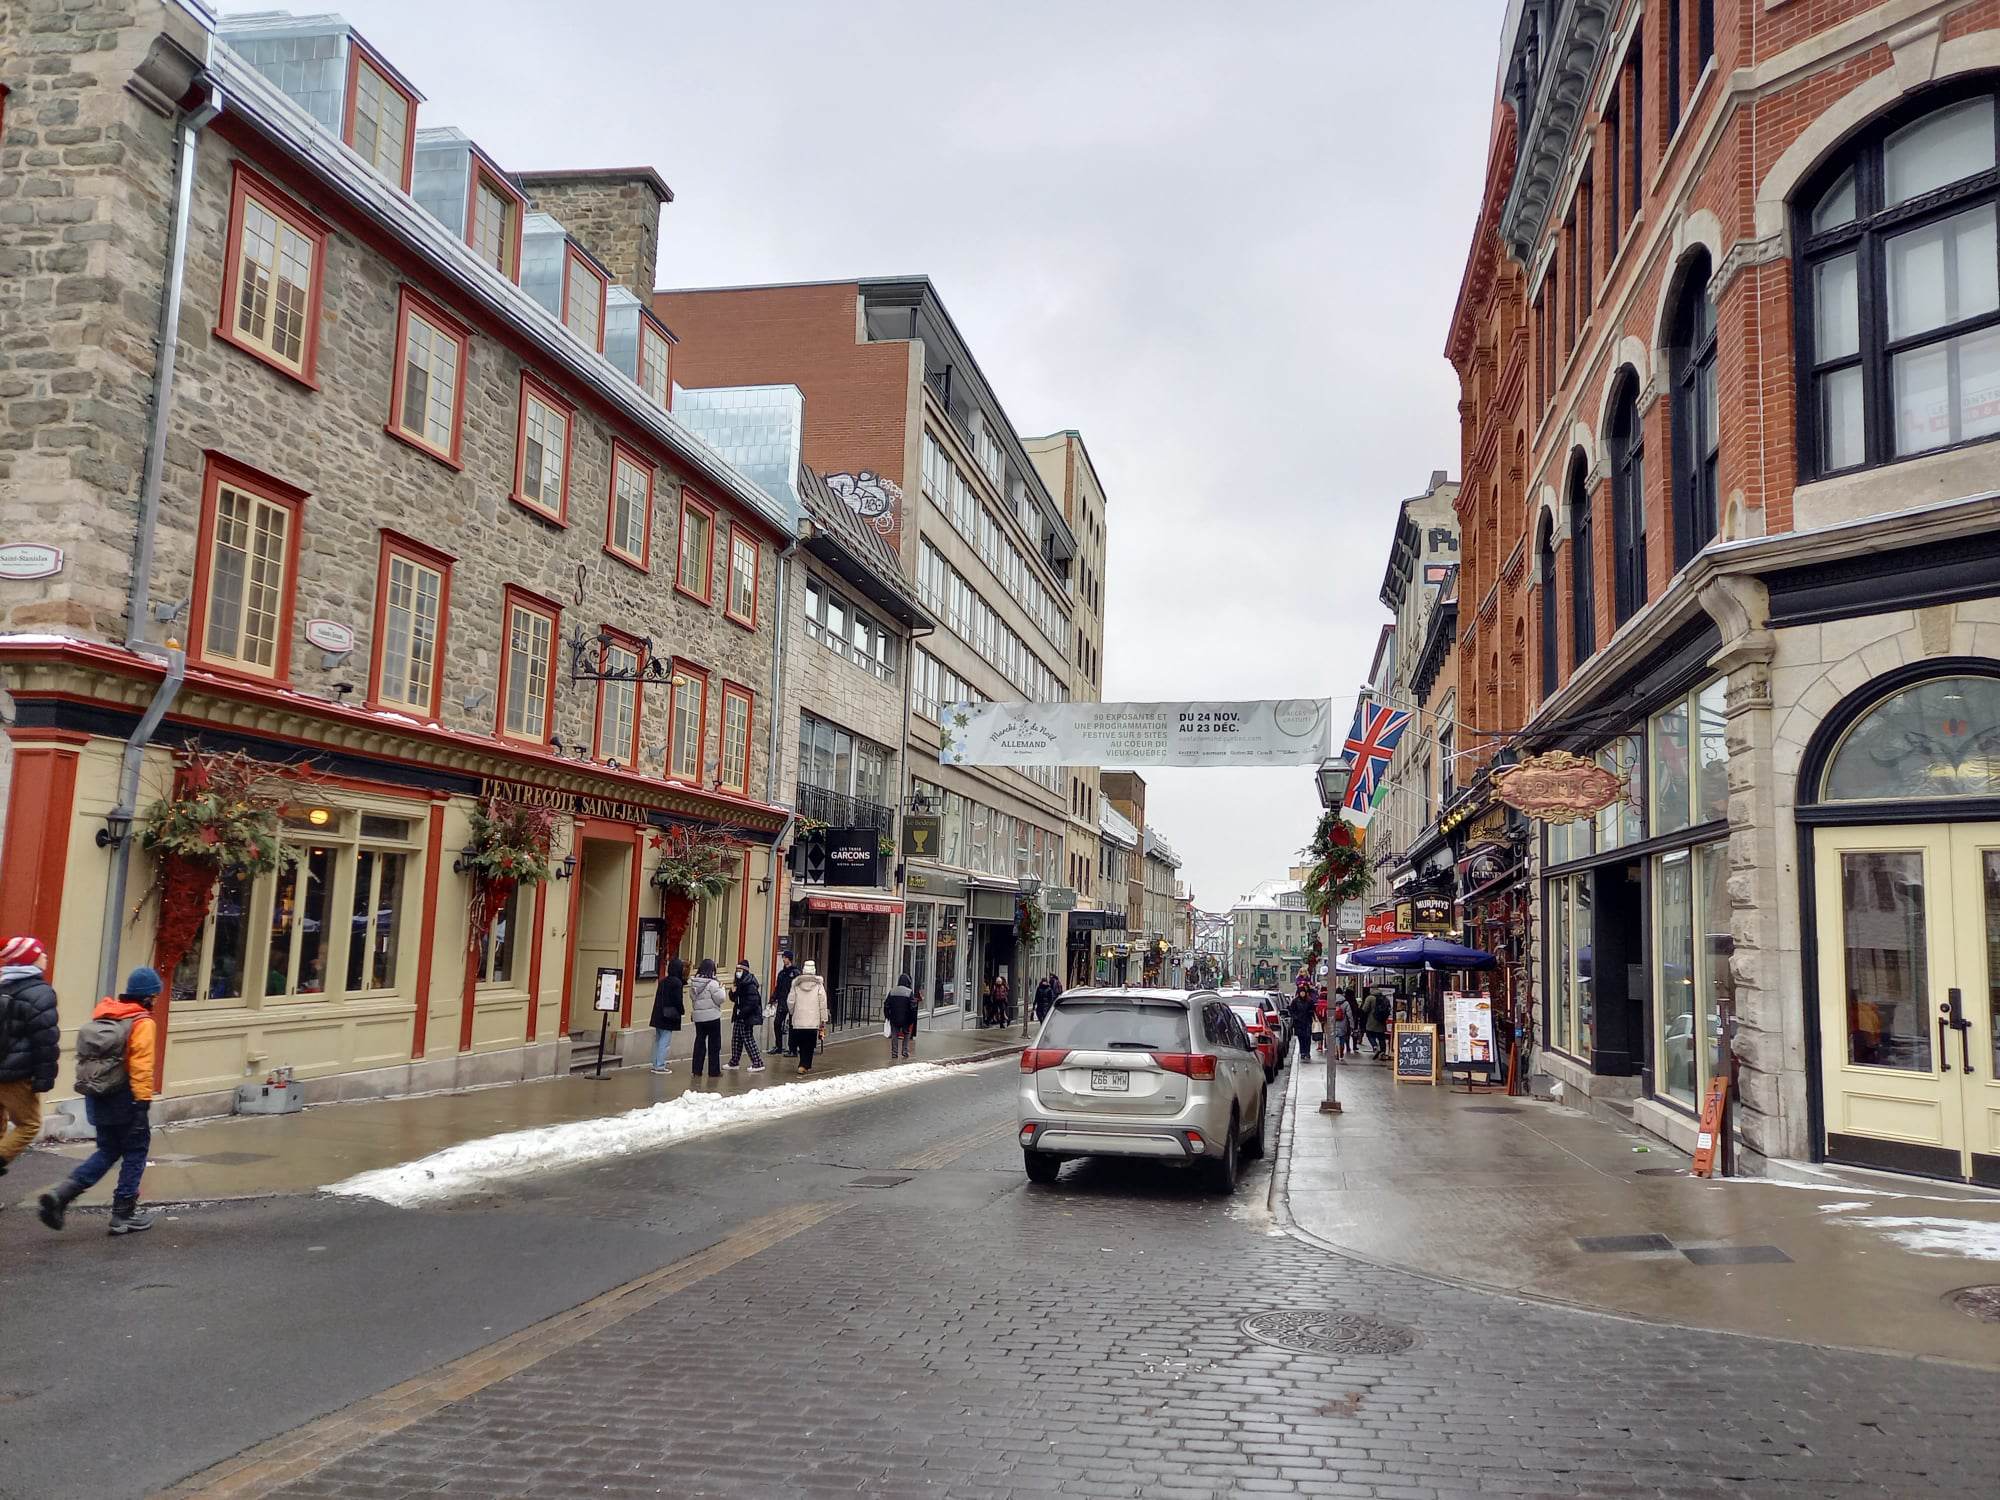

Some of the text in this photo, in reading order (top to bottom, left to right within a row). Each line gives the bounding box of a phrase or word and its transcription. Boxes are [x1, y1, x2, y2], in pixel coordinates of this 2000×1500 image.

[1179, 712, 1240, 721] DU 24 NOV.
[990, 722, 1016, 741] Marché
[1179, 722, 1240, 732] AU 23 DÉC.
[1000, 740, 1047, 748] ALLEMAND
[580, 796, 649, 824] SAINT-JEAN
